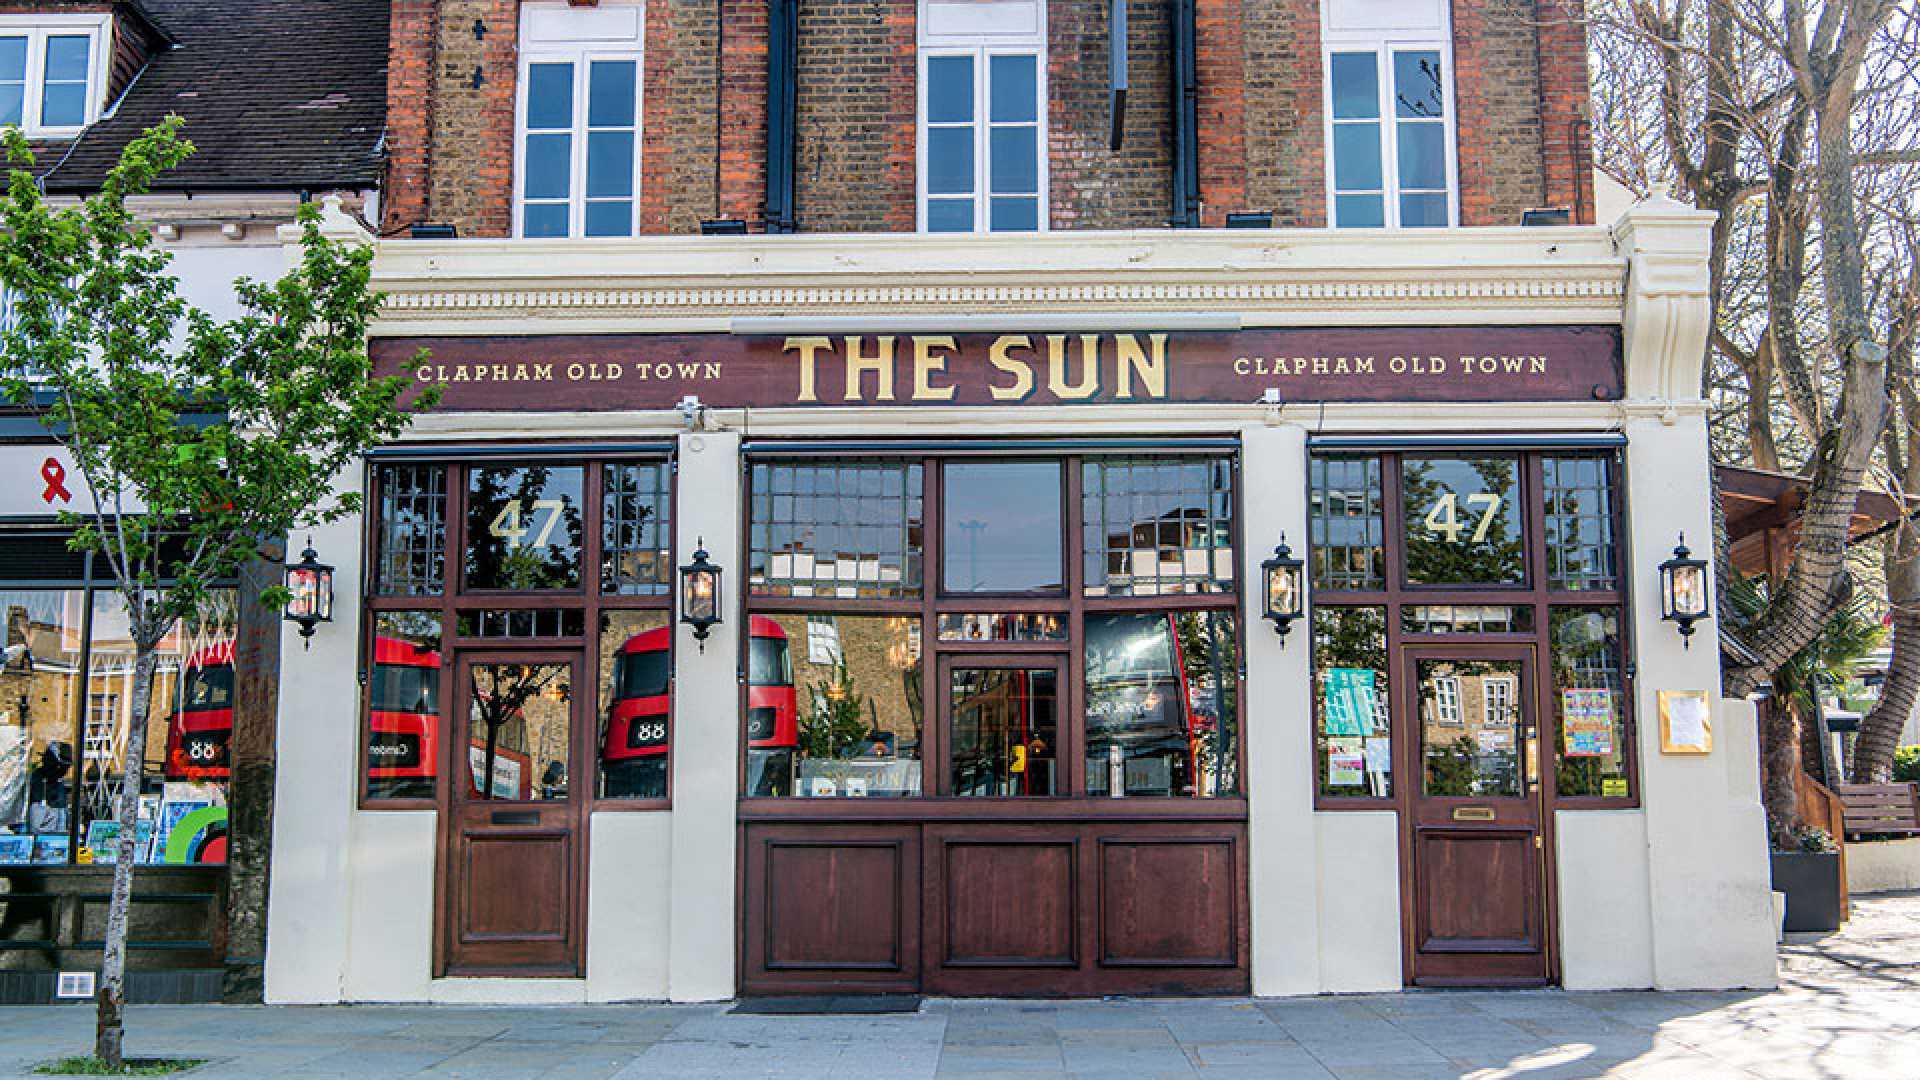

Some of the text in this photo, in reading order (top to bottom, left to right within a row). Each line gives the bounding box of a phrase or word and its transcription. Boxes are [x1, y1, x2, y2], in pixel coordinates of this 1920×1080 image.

[417, 362, 722, 382] CLAPHAM OLD TOWN
[783, 334, 1168, 400] THE SUN
[1233, 356, 1548, 375] CLAPHAM OLD TOWN
[488, 499, 564, 548] 47
[1424, 493, 1501, 543] 47
